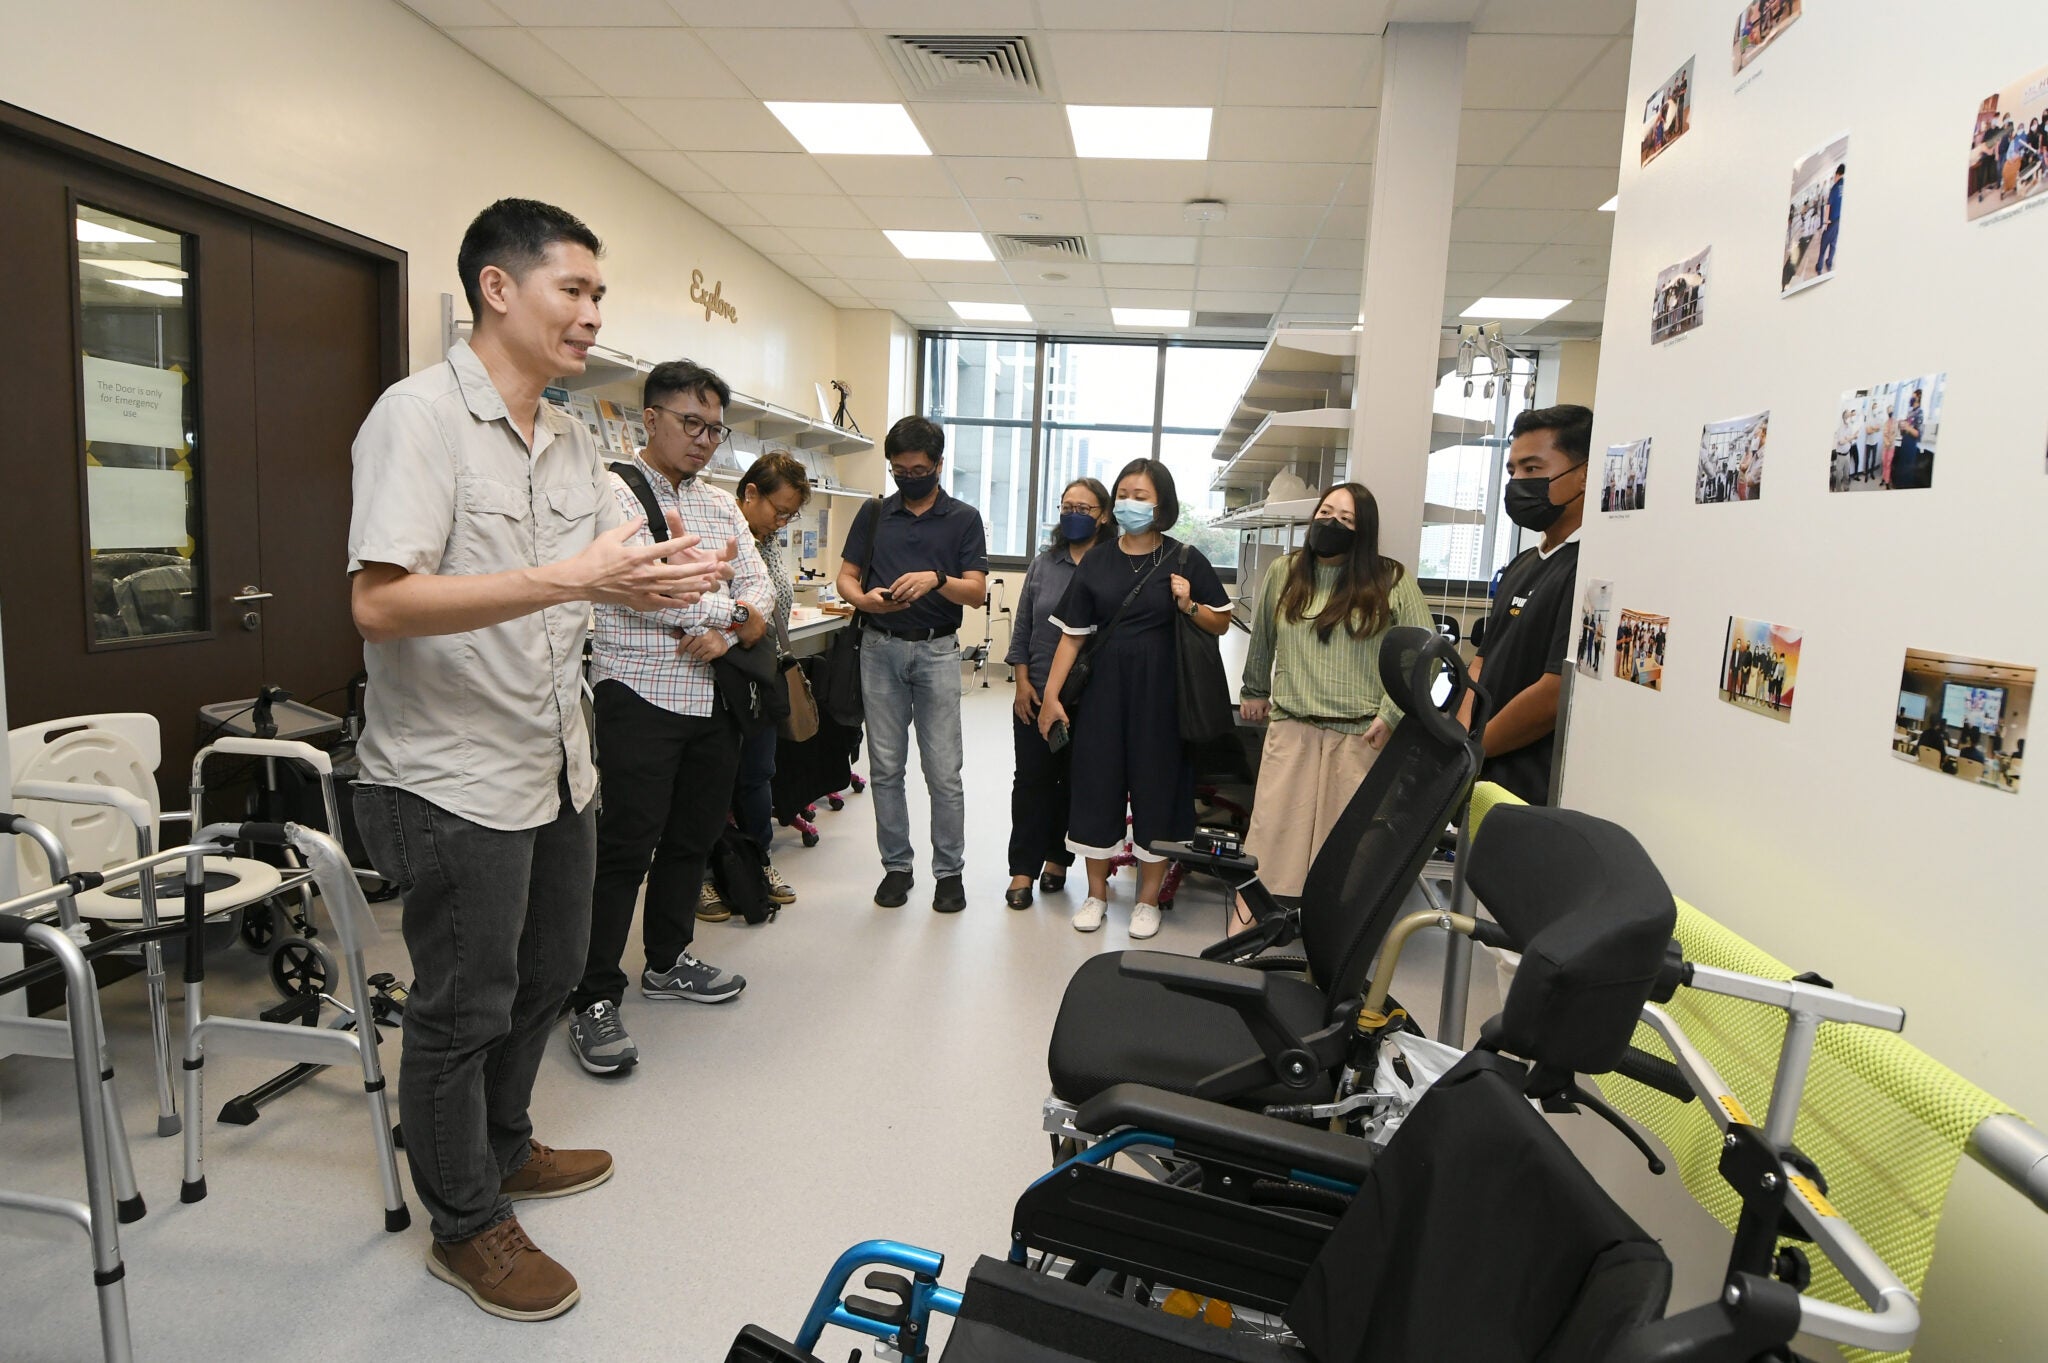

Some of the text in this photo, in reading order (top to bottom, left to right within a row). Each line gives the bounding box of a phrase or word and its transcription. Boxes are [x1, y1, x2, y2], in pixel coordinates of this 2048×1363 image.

[690, 269, 738, 324] Explore
[97, 380, 163, 399] The Door is only
[100, 393, 159, 410] for Emergency
[123, 409, 137, 418] use
